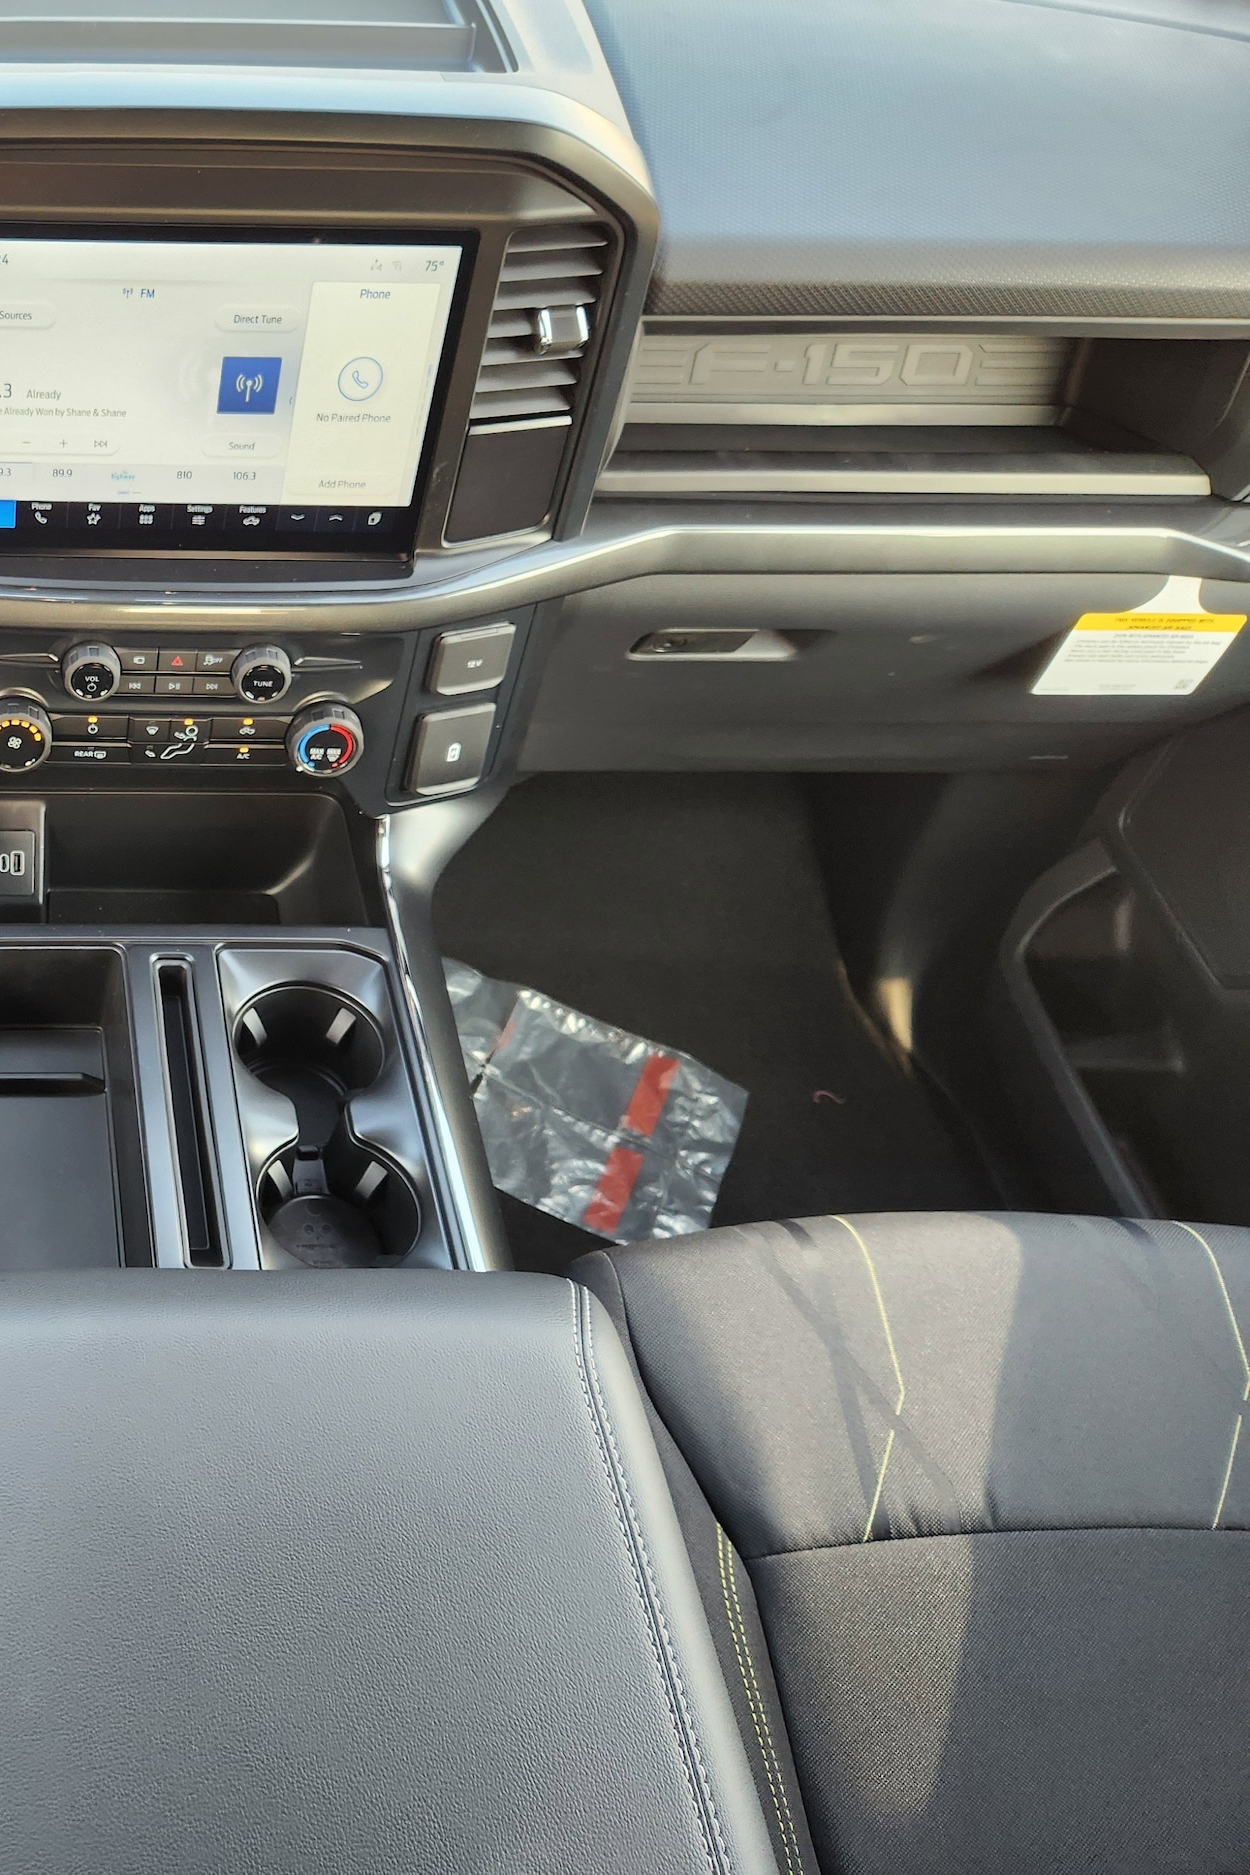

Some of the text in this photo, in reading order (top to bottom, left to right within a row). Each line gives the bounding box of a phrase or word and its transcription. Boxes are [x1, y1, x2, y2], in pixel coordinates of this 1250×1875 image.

[424, 260, 444, 272] 75°
[140, 288, 156, 299] FM
[360, 288, 391, 300] Phone
[233, 314, 283, 324] Direct Tune
[688, 341, 975, 387] F-150
[26, 389, 62, 402] Already
[4, 406, 34, 417] Already
[35, 408, 54, 416] Won
[55, 408, 65, 418] by
[66, 408, 91, 417] Shane
[92, 408, 99, 417] &
[101, 408, 126, 418] Shane
[316, 413, 391, 423] No Paired Phone
[228, 442, 255, 451] Sound
[52, 468, 73, 478] 89.9
[176, 470, 193, 480] 810
[233, 471, 256, 481] 106.3
[318, 480, 366, 489] Add Phone
[31, 502, 52, 511] Phone
[88, 503, 101, 512] Fav
[138, 504, 155, 514] Apps
[186, 504, 213, 514] Settings
[239, 505, 267, 514] Features
